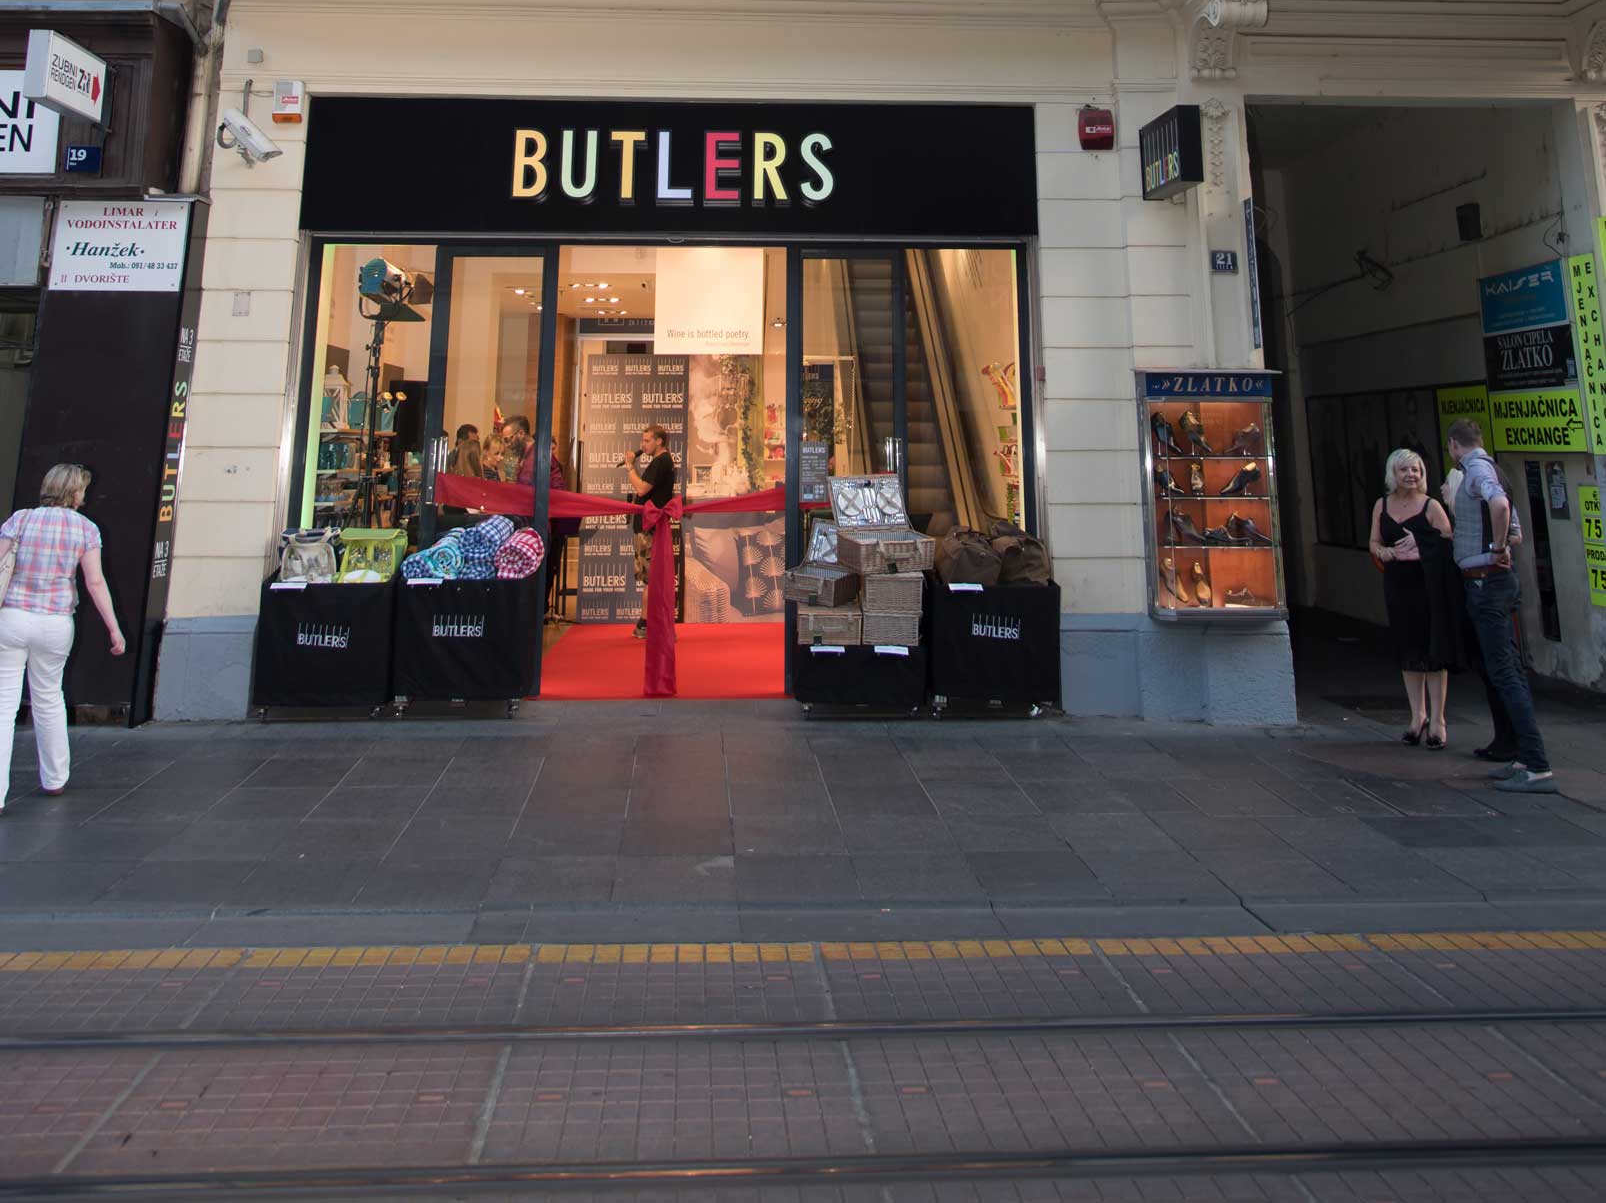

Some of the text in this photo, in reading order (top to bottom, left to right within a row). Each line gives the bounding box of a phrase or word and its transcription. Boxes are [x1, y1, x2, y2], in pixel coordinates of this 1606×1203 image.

[52, 54, 78, 77] ZUBNI
[51, 68, 76, 91] RENDGEN
[69, 149, 87, 161] 19
[512, 129, 835, 201] BUTLERS
[1145, 151, 1180, 192] BUTLERS
[103, 207, 144, 217] LIMAR
[67, 219, 177, 230] VODOINSTALATER
[1216, 252, 1233, 265] 21
[74, 273, 130, 283] DVORIŠTE
[1485, 271, 1555, 296] KAISER
[187, 329, 194, 345] 3
[667, 329, 686, 338] Wine
[688, 330, 695, 338] is
[696, 329, 723, 338] bottled
[1497, 329, 1554, 350] SALON CIPELA
[1501, 345, 1554, 371] ZLATKO
[1573, 265, 1603, 446] MJENJAČNICA
[592, 364, 619, 372] BUTLERS
[625, 364, 652, 372] BUTLERS
[658, 364, 685, 372] BUTLERS
[591, 393, 632, 404] BUTLERS
[642, 393, 684, 404] BUTLERS
[1493, 395, 1578, 420] MJENJAČNICA
[1506, 427, 1571, 446] EXCHANGE
[159, 381, 188, 522] BUTLERS
[1585, 519, 1602, 538] 75
[154, 541, 170, 558] NA 3
[584, 544, 612, 552] BUTLERS
[583, 575, 626, 586] BUTLERS
[433, 624, 483, 637] BUTLERS
[972, 623, 1018, 640] BUTLERS
[297, 633, 348, 648] BUTLERS
